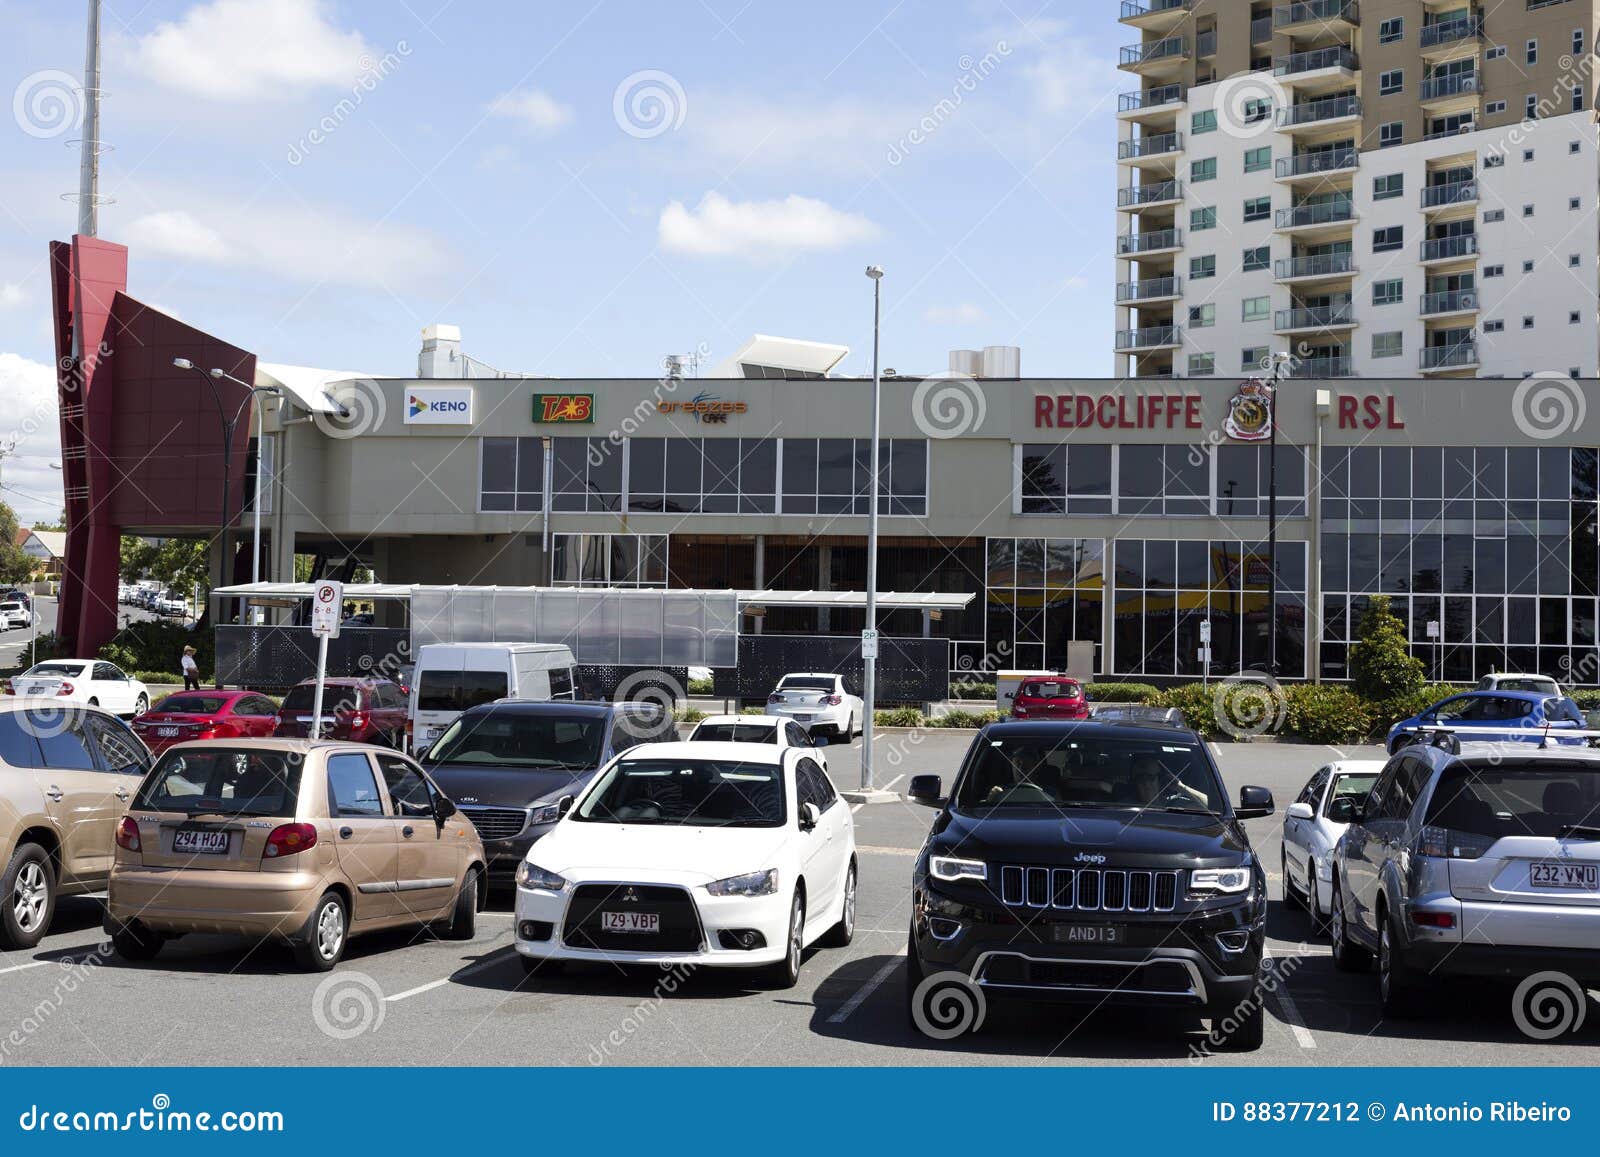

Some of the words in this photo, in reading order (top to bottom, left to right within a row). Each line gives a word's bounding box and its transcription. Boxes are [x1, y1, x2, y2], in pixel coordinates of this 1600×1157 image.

[431, 401, 467, 412] KENO
[541, 395, 592, 421] TAB
[1035, 395, 1202, 429] REDCLIFFE
[1339, 395, 1404, 429] RSL
[863, 632, 876, 640] 2P
[1074, 852, 1106, 865] Jeep
